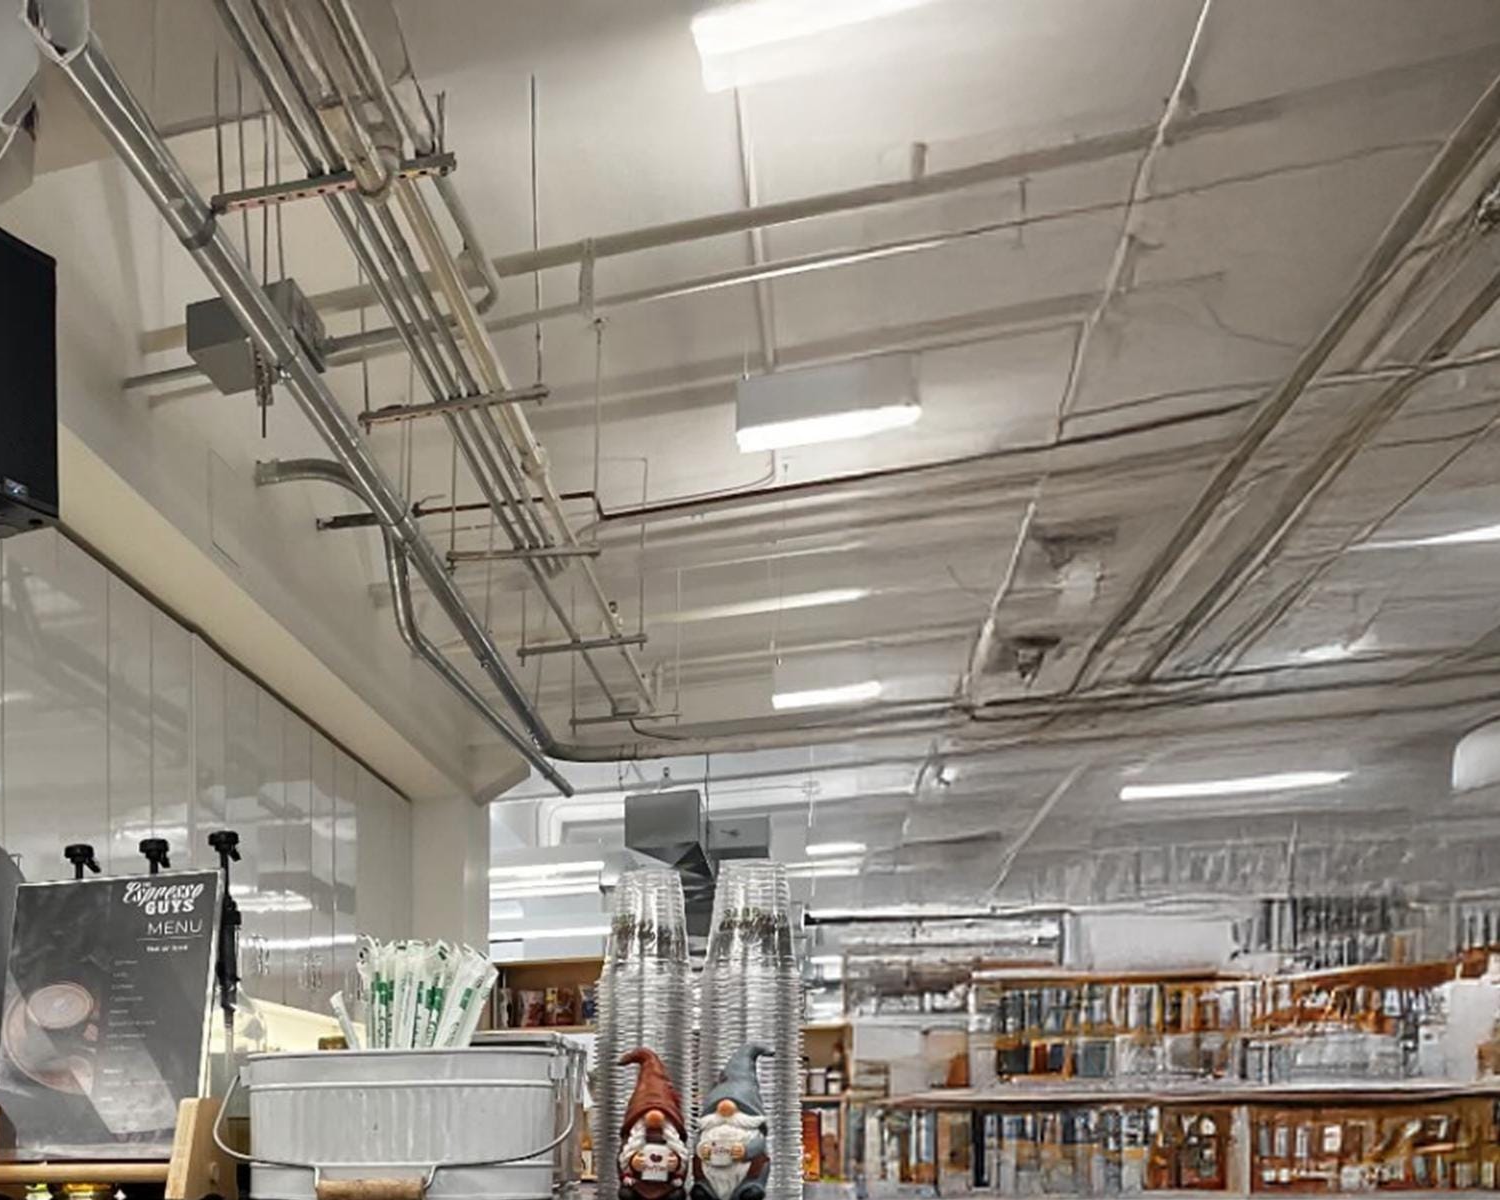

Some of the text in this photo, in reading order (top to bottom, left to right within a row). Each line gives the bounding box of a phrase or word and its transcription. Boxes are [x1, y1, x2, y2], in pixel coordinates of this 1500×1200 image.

[122, 881, 205, 907] Espresso
[144, 899, 195, 916] GUYS
[147, 919, 203, 936] MENU
